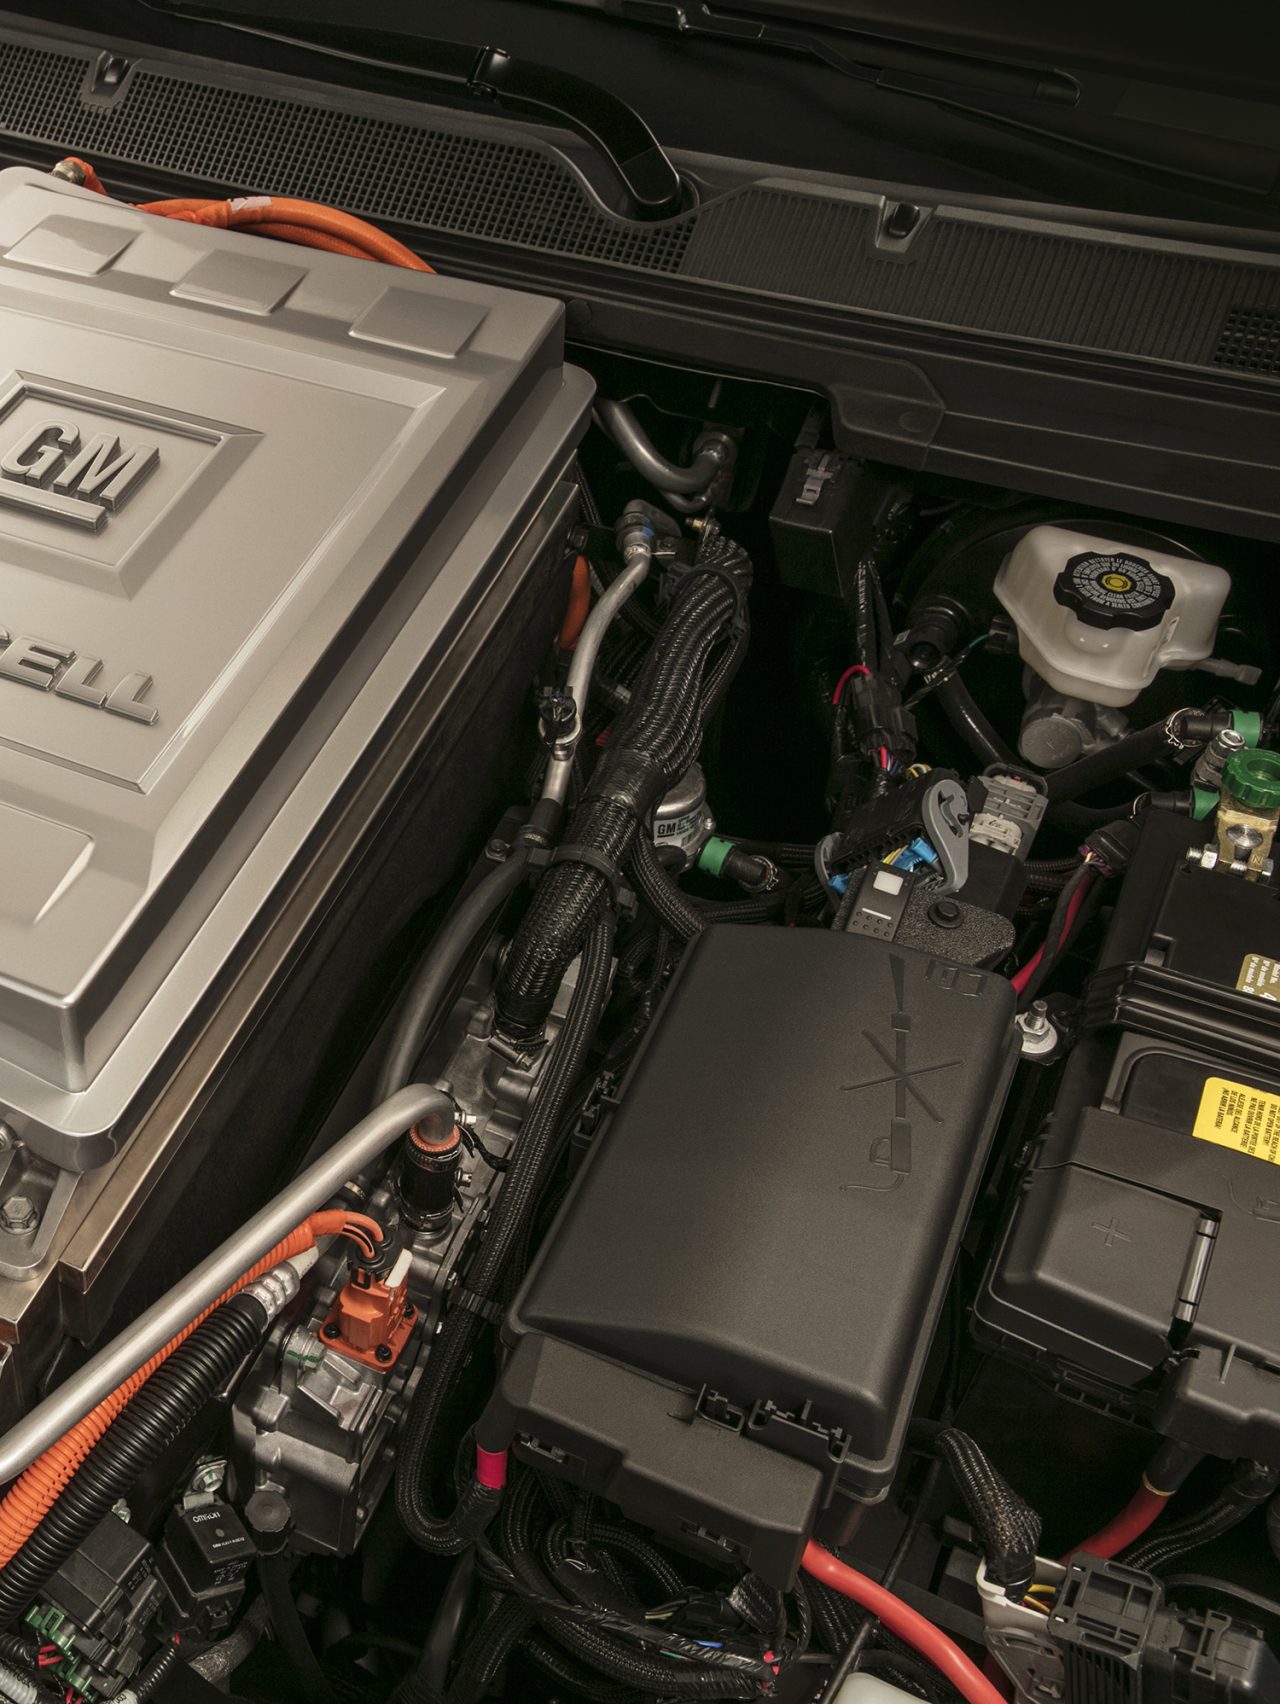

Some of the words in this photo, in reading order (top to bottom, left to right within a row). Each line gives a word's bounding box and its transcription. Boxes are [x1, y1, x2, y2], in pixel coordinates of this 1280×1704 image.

[0, 419, 160, 511] GM
[657, 822, 675, 834] GM
[192, 1511, 220, 1523] OMRON
